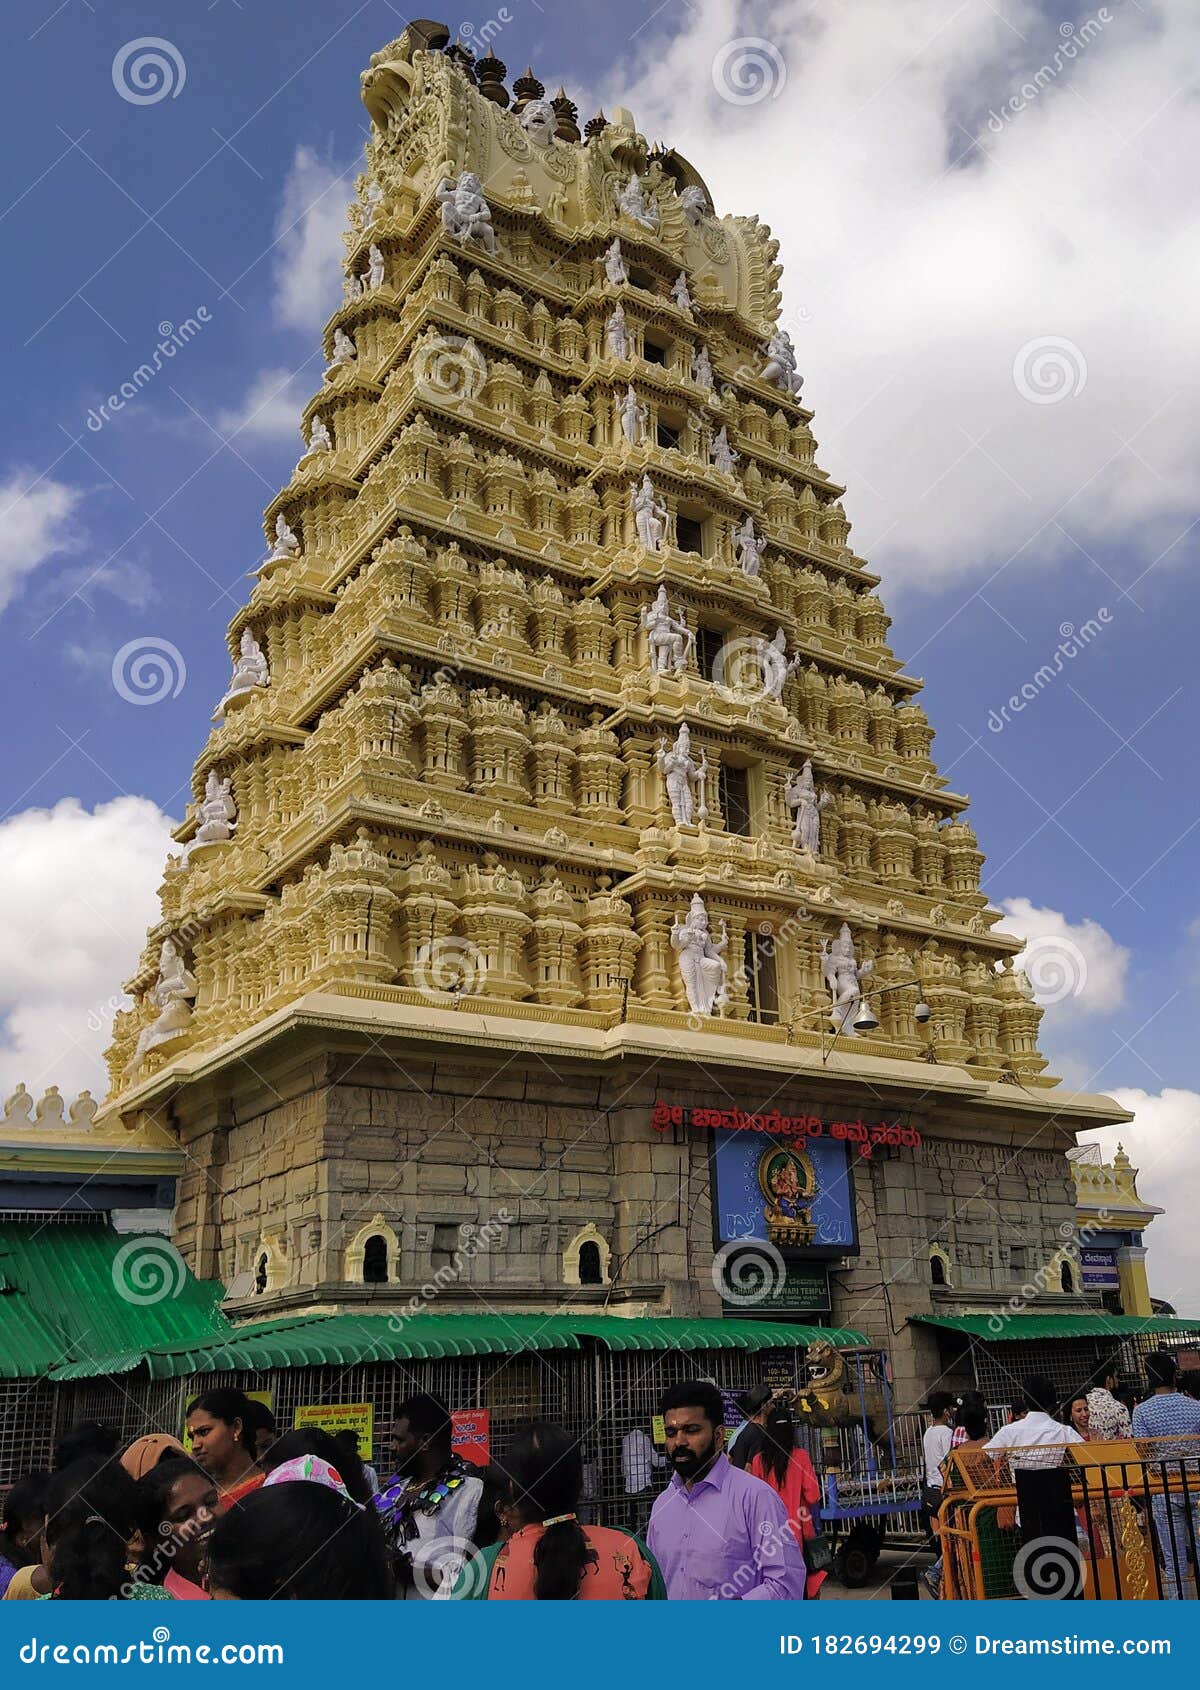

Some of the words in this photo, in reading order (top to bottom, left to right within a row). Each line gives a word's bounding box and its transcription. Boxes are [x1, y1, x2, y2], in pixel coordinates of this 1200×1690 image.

[652, 1099, 683, 1133] ಶ್ರೀ
[690, 1106, 823, 1151] ಚಾಮುಂಡೇಶ್ವರಿ
[801, 1287, 828, 1295] TEMPLE
